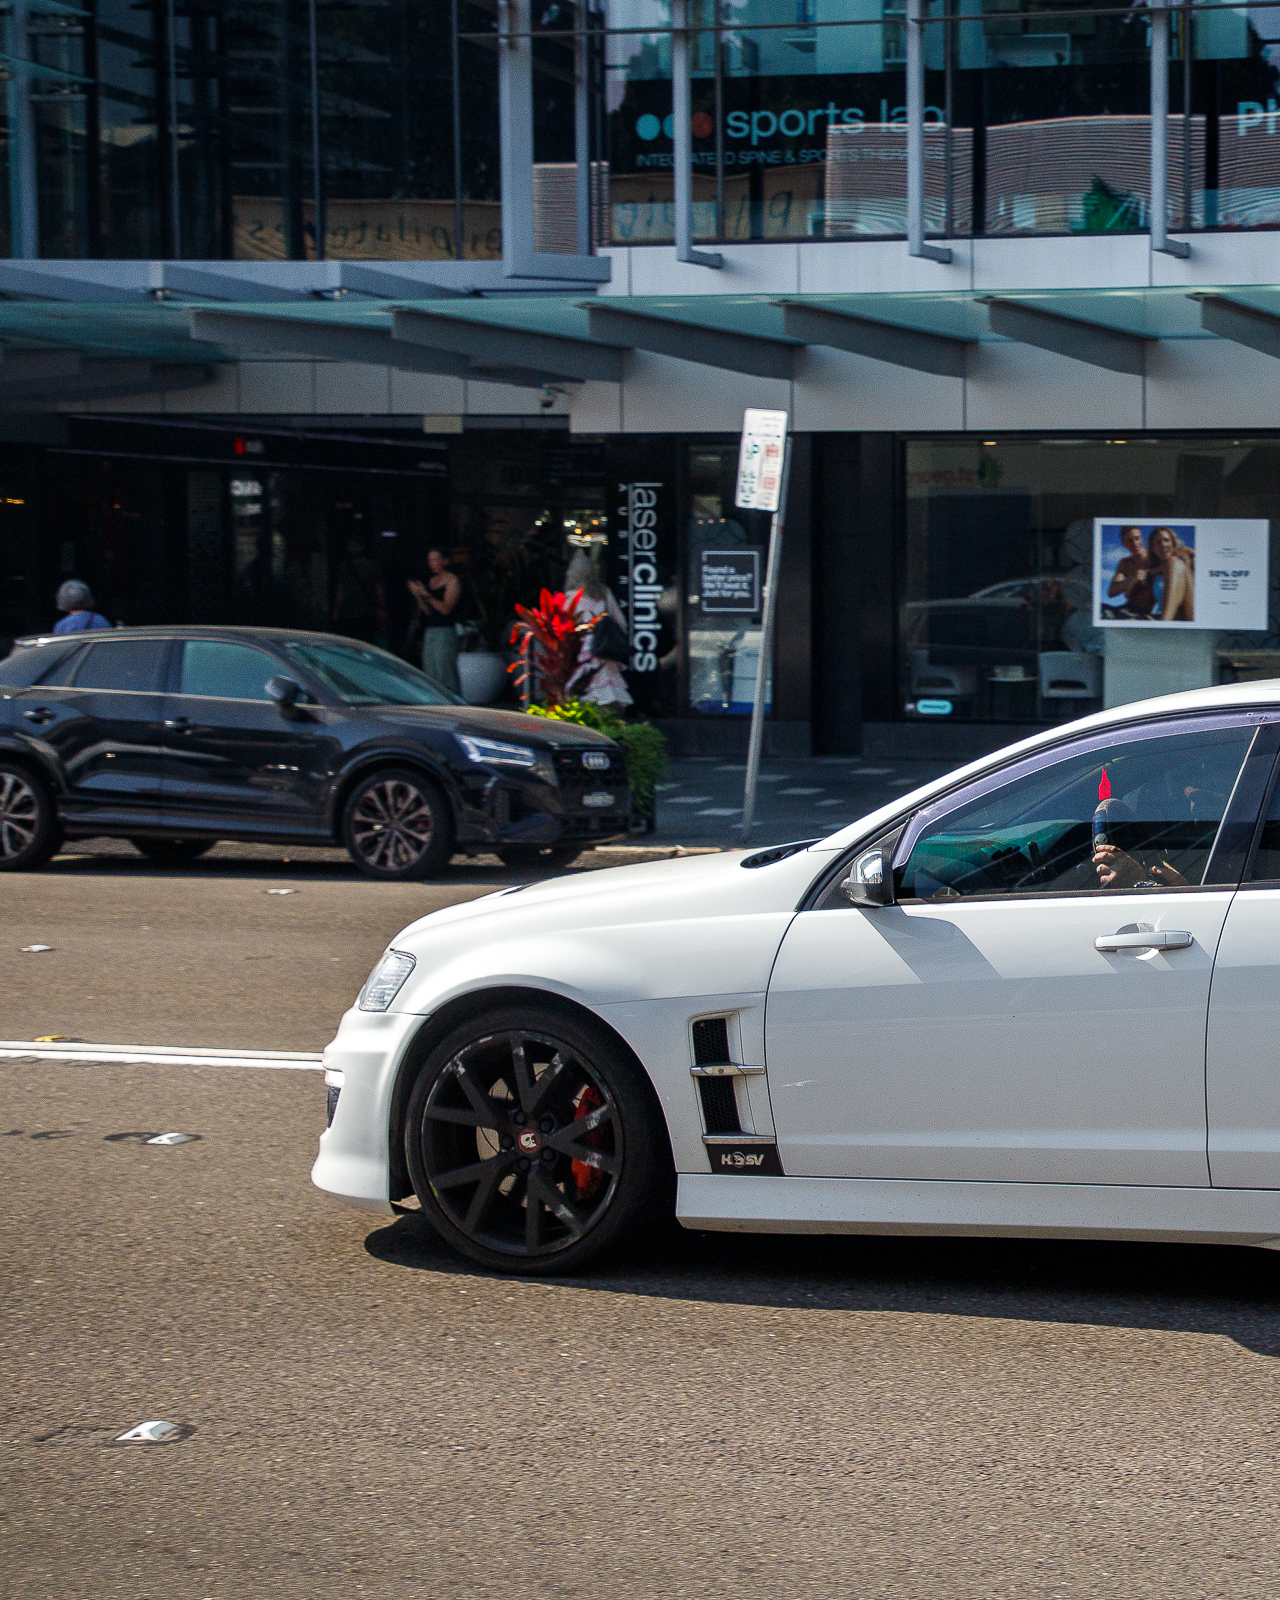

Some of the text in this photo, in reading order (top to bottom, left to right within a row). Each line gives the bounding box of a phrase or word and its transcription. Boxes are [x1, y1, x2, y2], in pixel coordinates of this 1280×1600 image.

[726, 102, 866, 146] sports
[738, 150, 781, 165] SPINE
[634, 482, 664, 672] laserclinics
